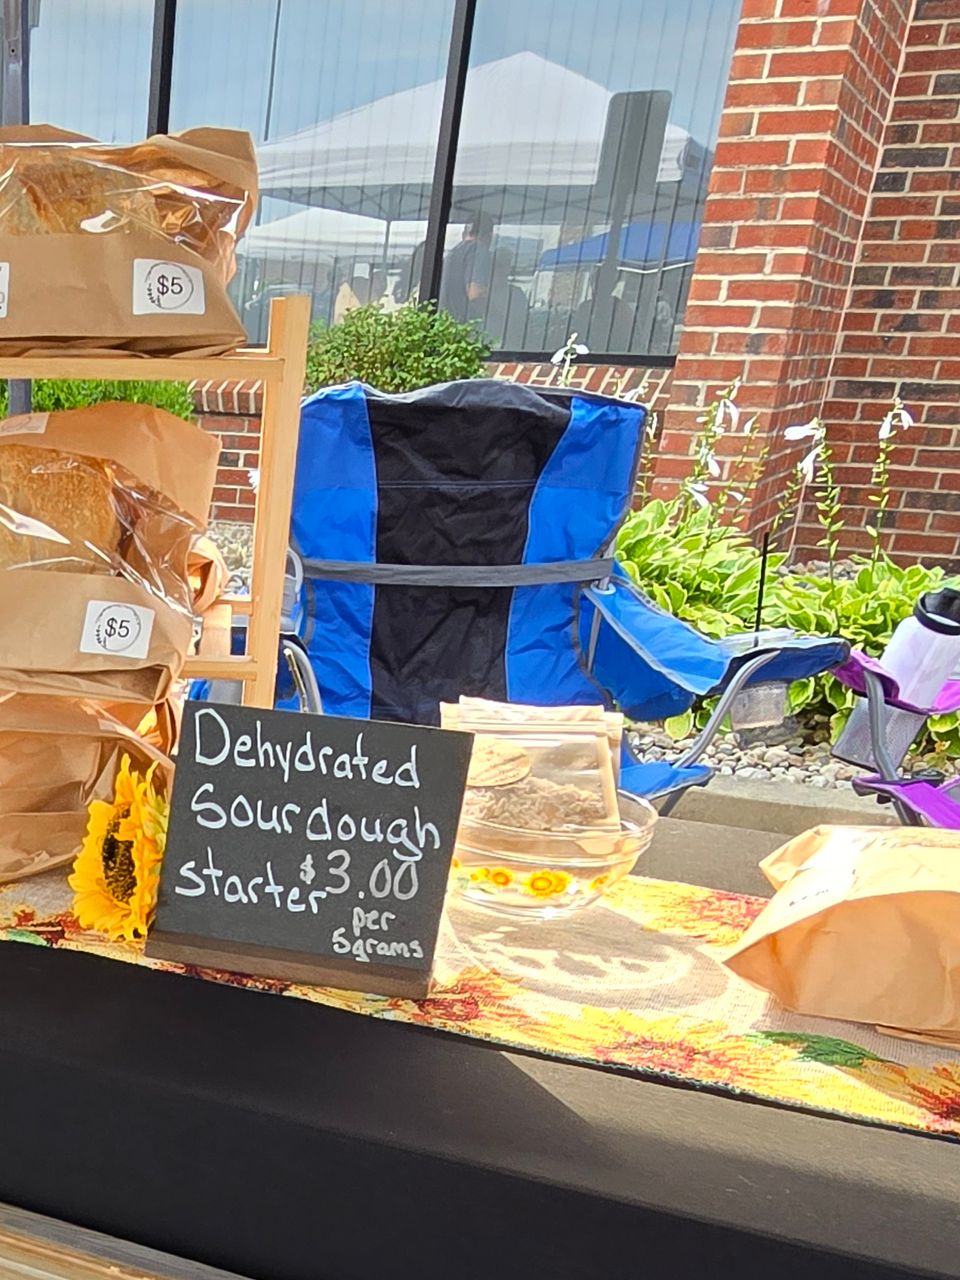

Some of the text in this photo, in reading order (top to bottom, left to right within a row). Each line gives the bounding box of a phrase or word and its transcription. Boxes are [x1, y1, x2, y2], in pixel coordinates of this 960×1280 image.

[157, 274, 183, 296] $5
[104, 617, 130, 638] $5
[194, 708, 420, 789] Dehydrated
[190, 782, 441, 861] Sourdough
[299, 849, 419, 901] $3.00
[352, 906, 395, 937] per
